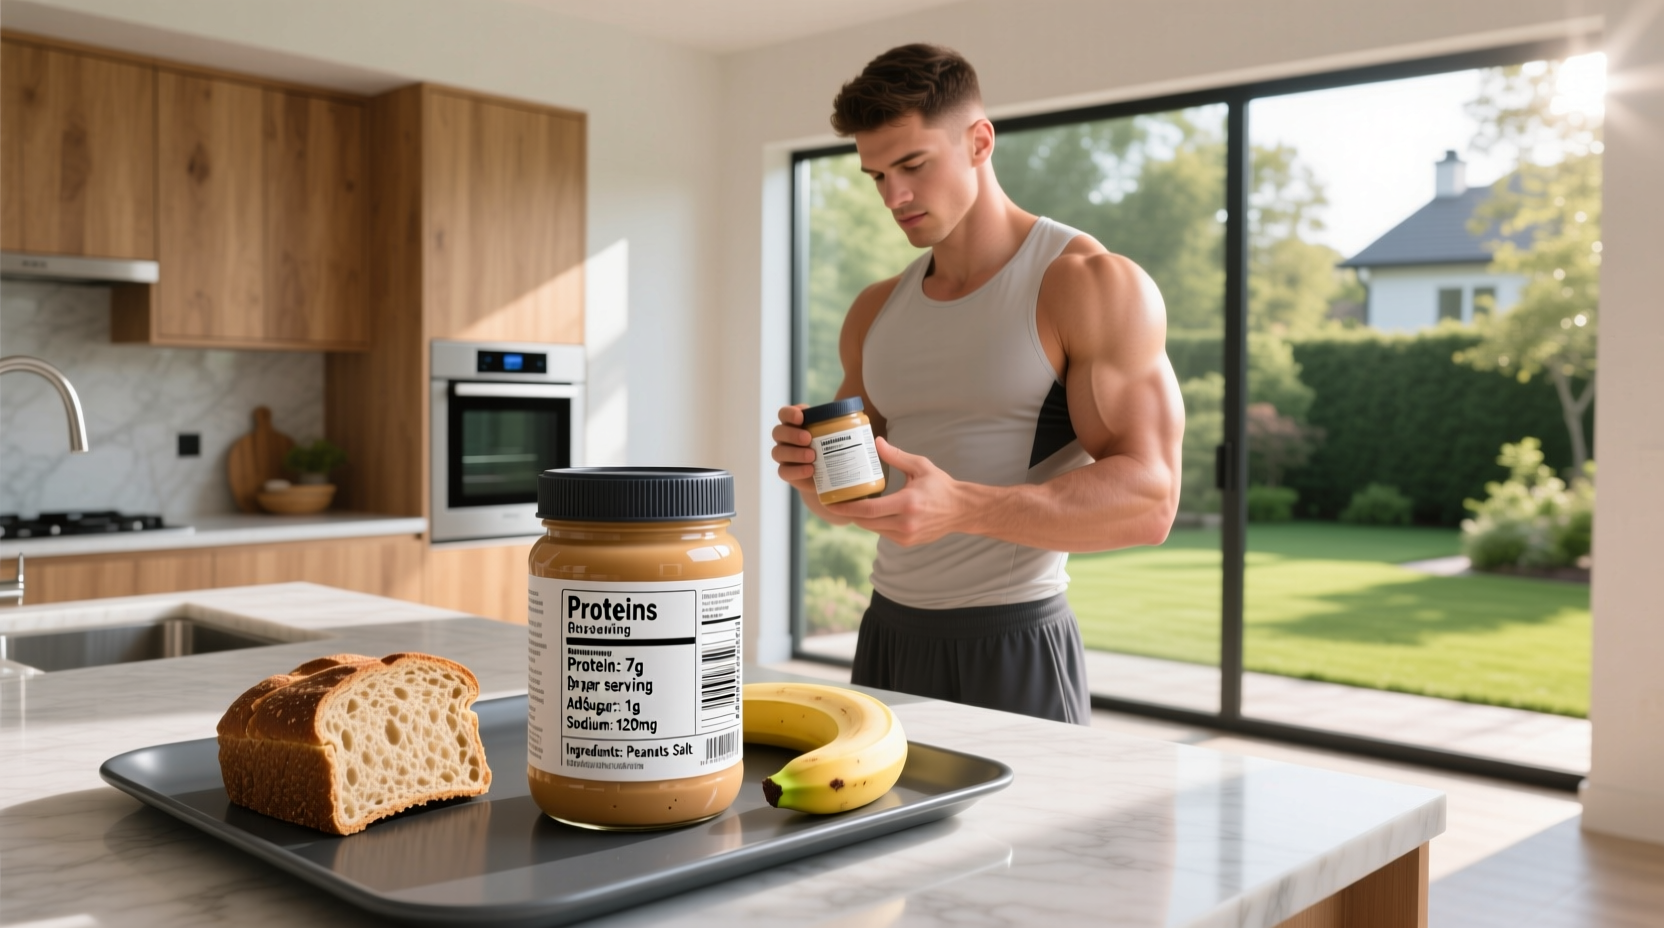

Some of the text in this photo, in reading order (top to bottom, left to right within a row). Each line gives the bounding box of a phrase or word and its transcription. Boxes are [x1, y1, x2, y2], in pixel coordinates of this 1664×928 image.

[568, 595, 657, 621] Proteins
[625, 657, 644, 677] 7g
[604, 677, 653, 695] serving
[625, 699, 640, 715] 1g
[566, 715, 657, 734] Sodium: 120mg
[672, 742, 693, 756] Salt
